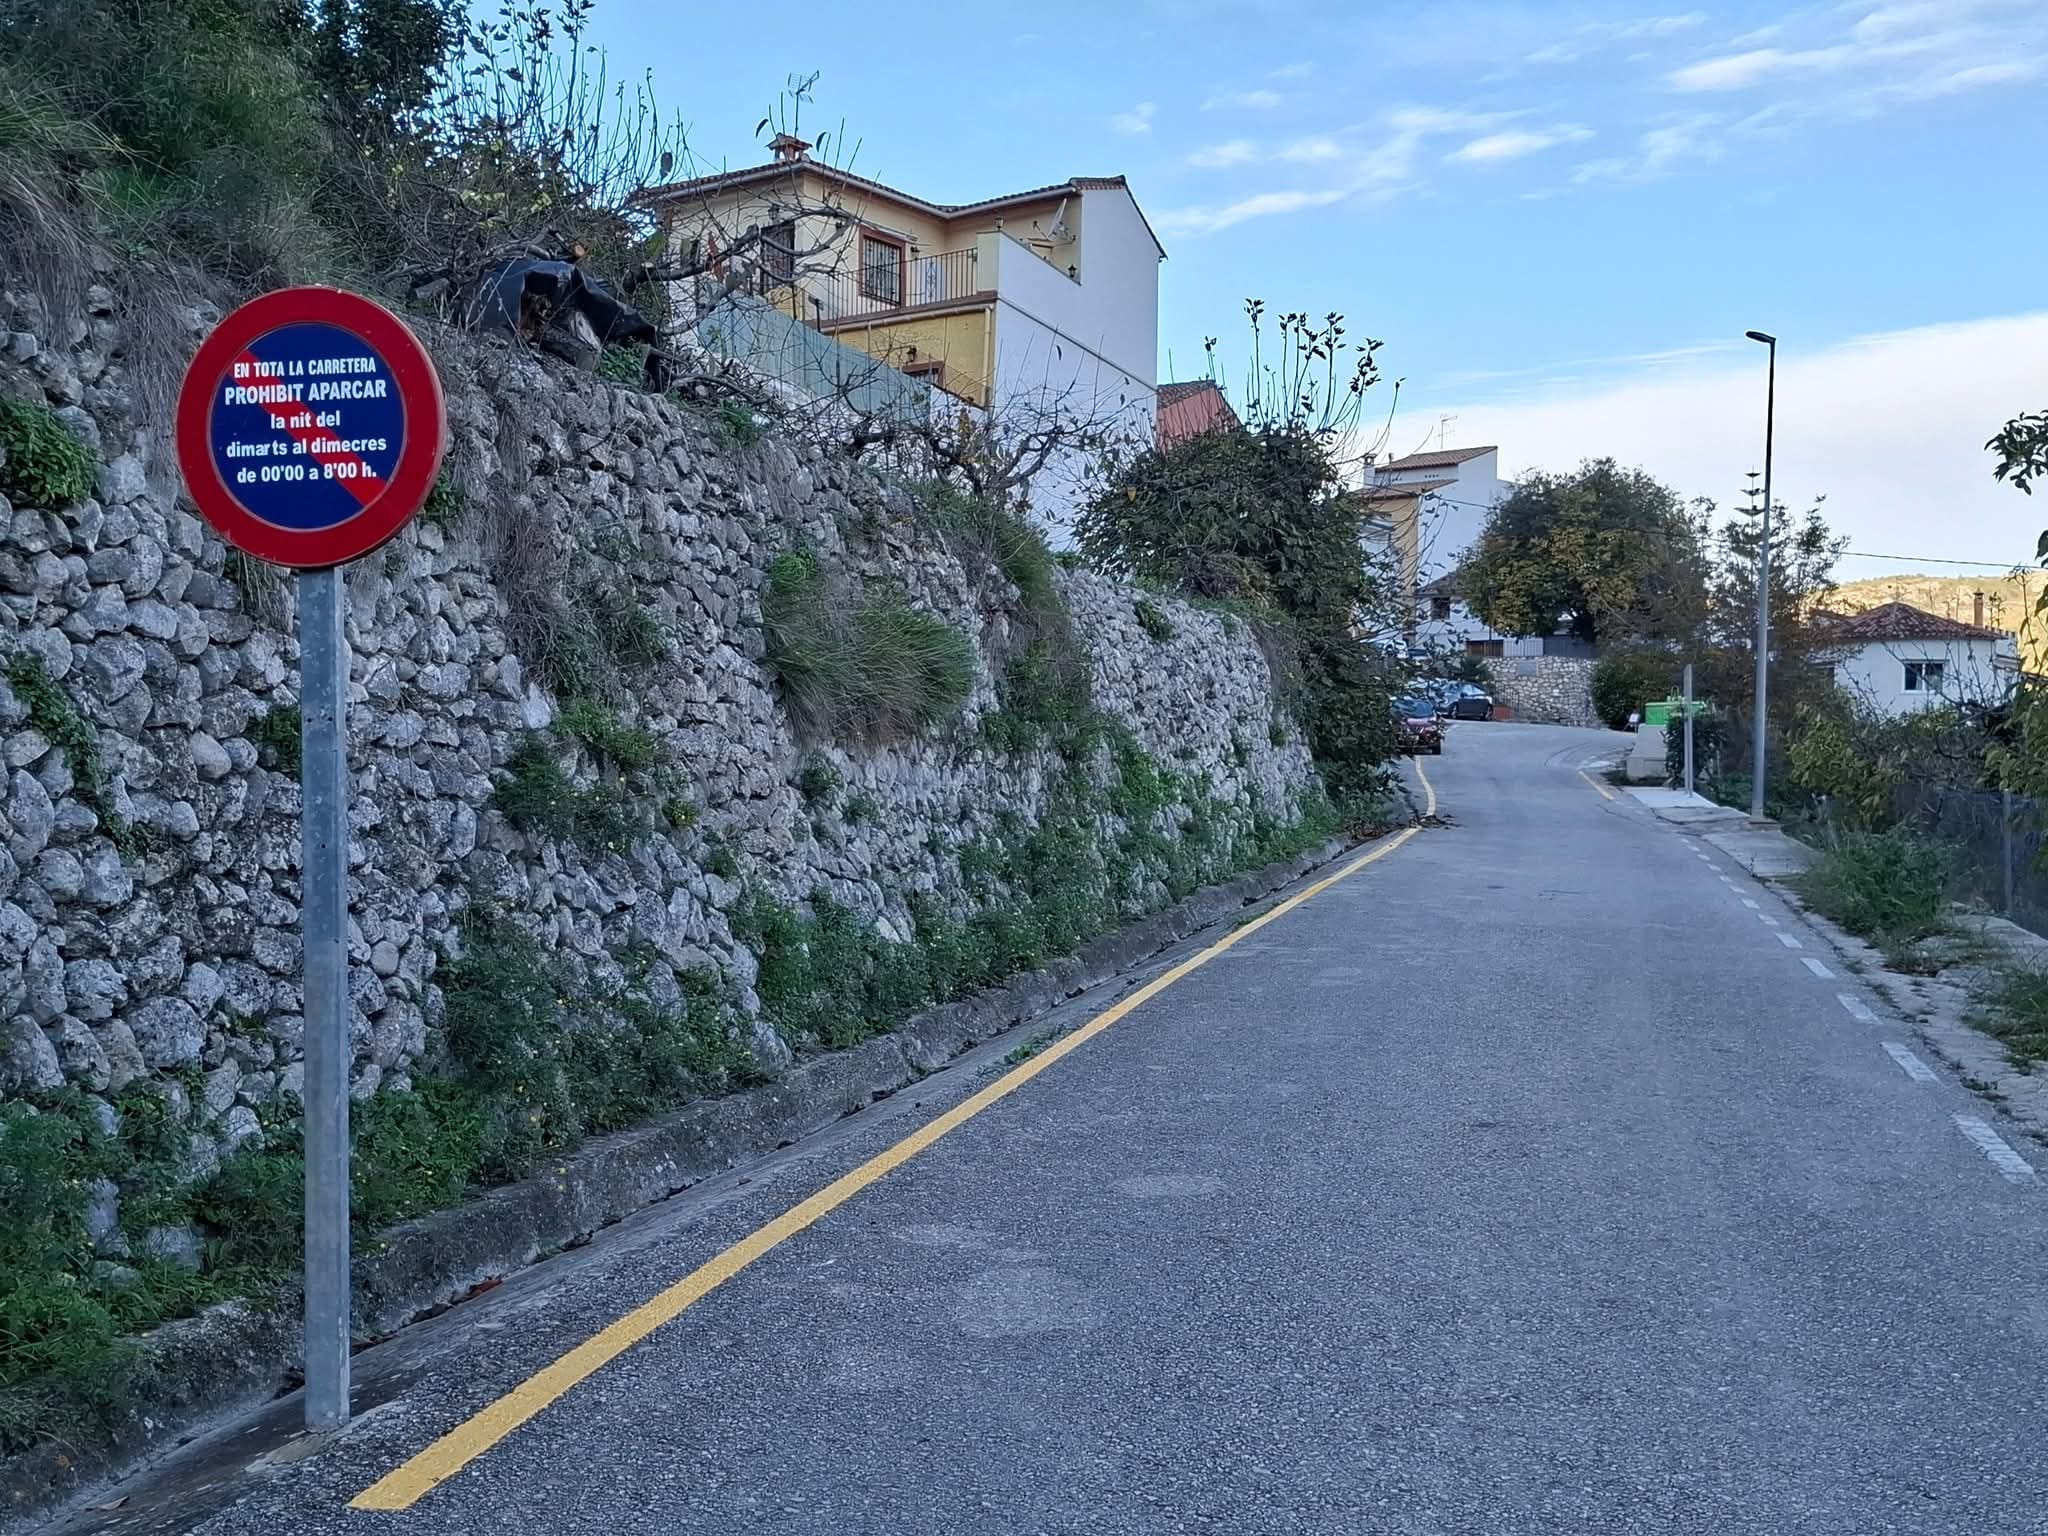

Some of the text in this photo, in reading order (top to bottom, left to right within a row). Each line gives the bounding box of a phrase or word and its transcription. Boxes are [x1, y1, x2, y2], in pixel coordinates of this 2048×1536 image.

[234, 357, 376, 379] EN TOTA LA CARRETERA
[225, 379, 387, 405] PROHIBIT APARCAR
[271, 411, 340, 429] la nit del
[226, 438, 387, 457] dimarts al dimecres
[237, 468, 256, 483] de
[309, 467, 319, 480] a
[362, 462, 377, 478] h.
